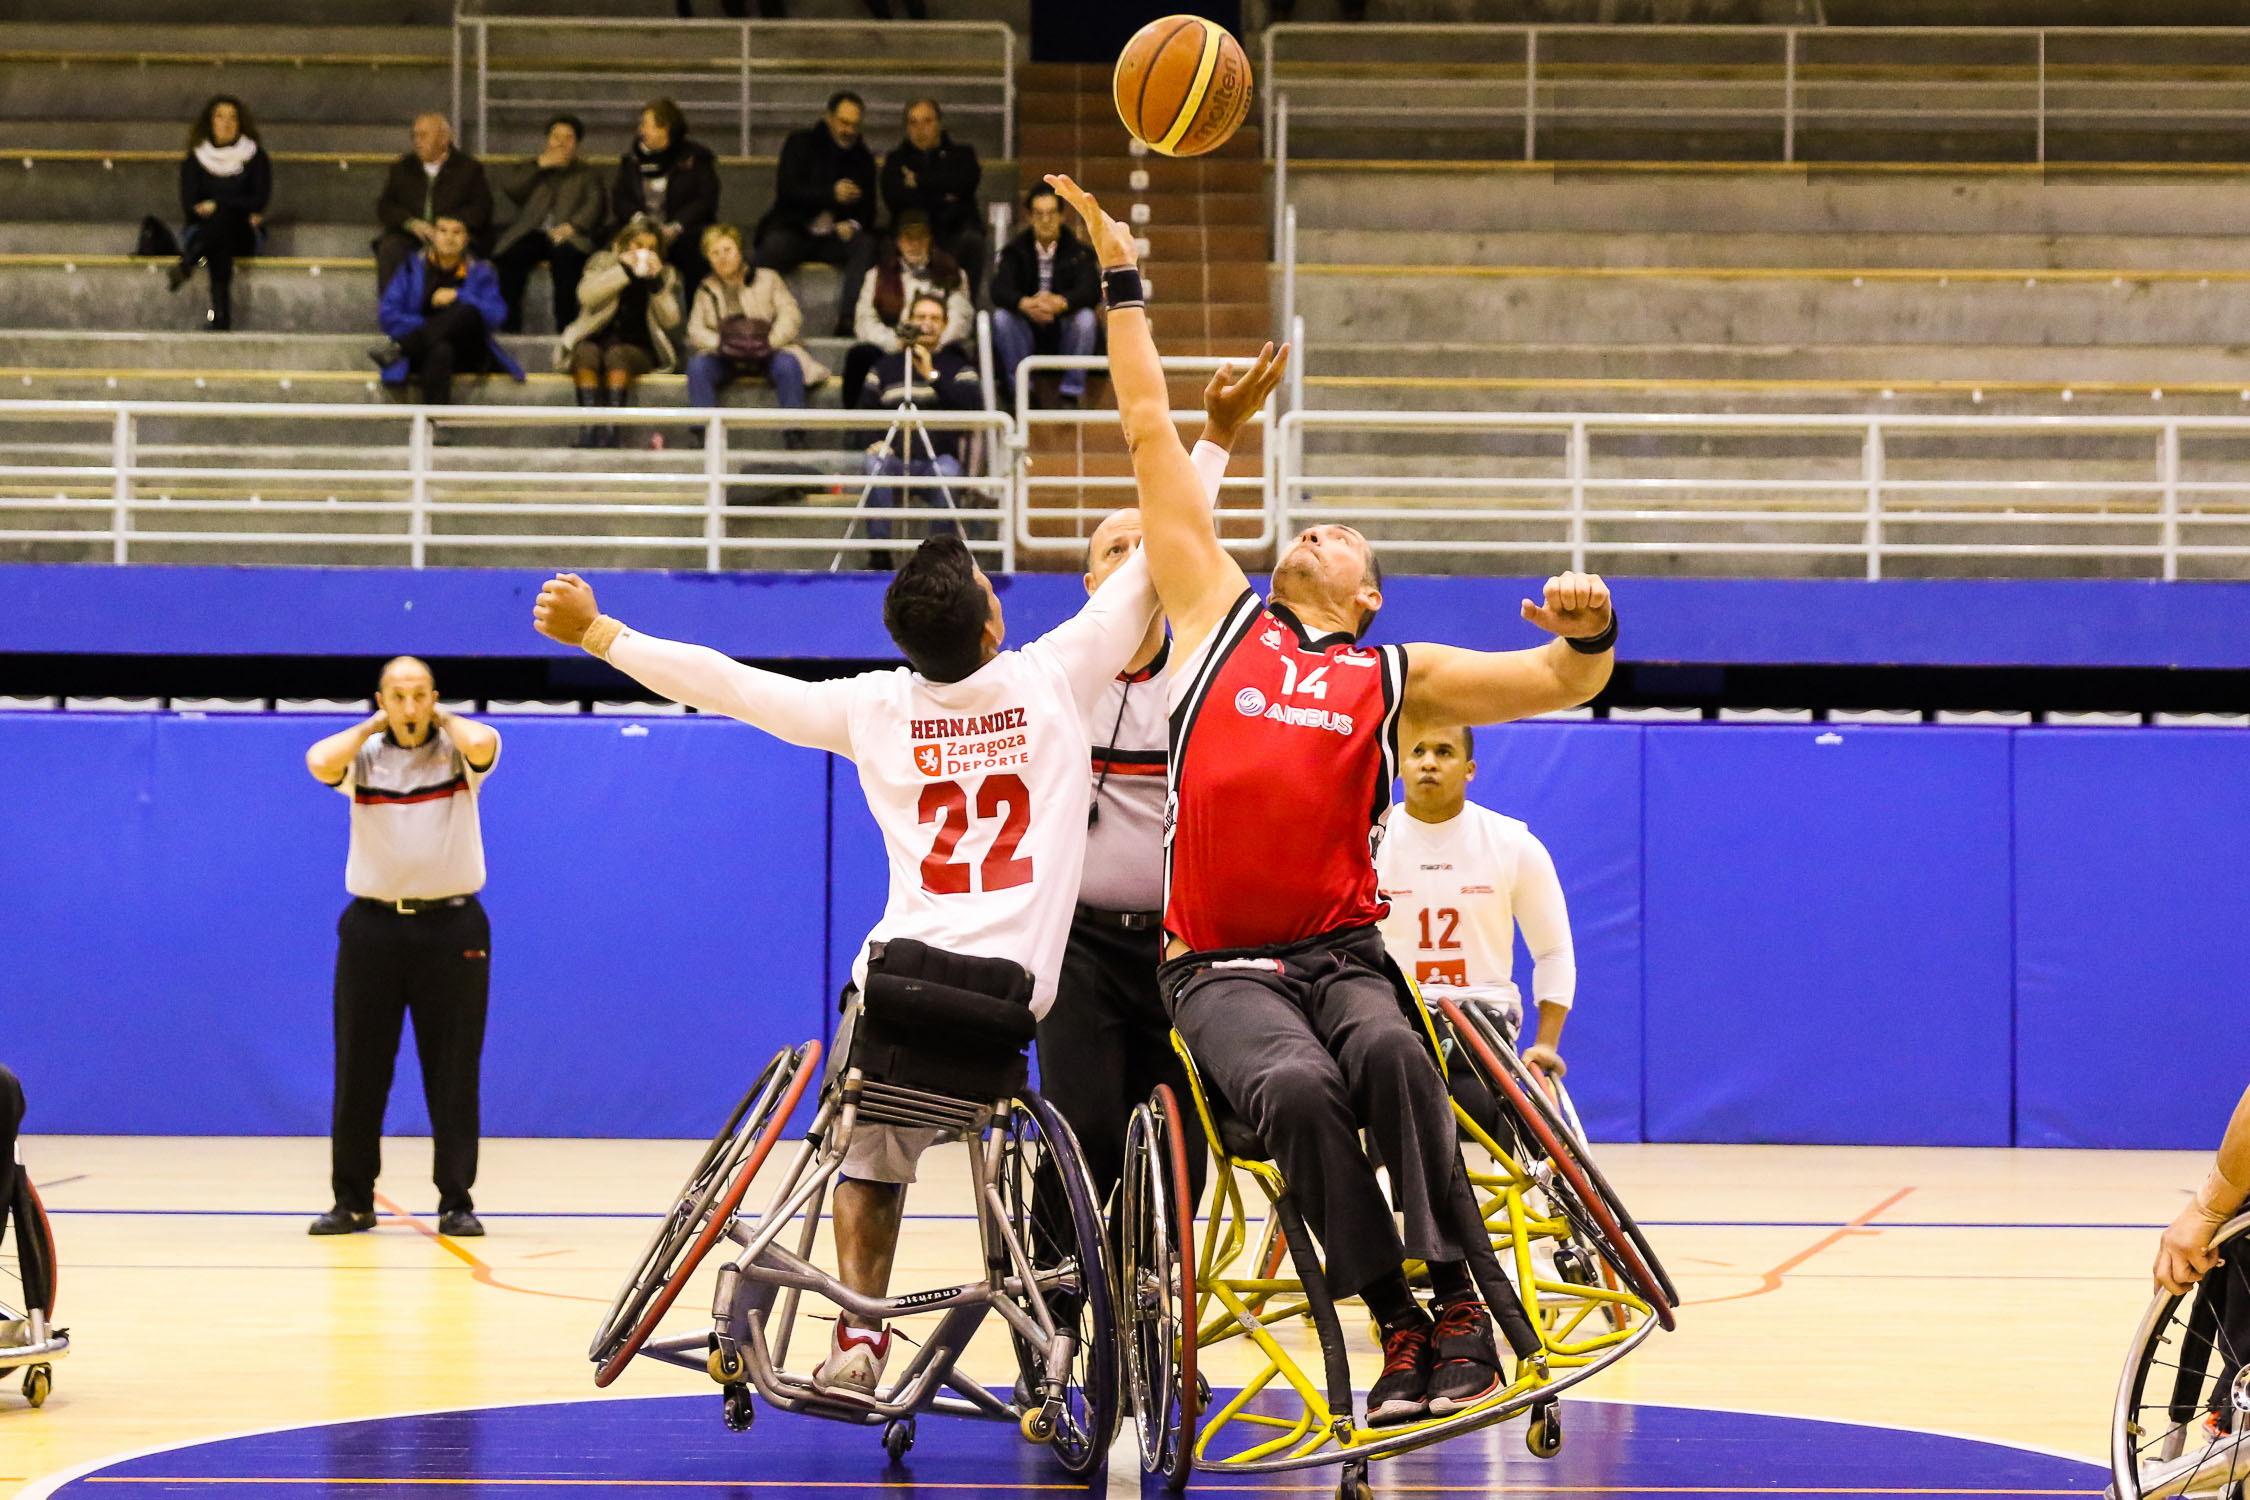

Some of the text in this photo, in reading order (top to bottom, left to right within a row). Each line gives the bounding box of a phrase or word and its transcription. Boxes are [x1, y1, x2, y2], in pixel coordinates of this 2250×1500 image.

[1194, 57, 1237, 139] molten
[1280, 655, 1330, 699] 14
[911, 708, 1027, 739] HERNANDEZ
[1264, 703, 1354, 736] AIRBUS
[948, 735, 1027, 757] Zaragoza
[917, 774, 1033, 894] 22
[1418, 907, 1462, 950] 12
